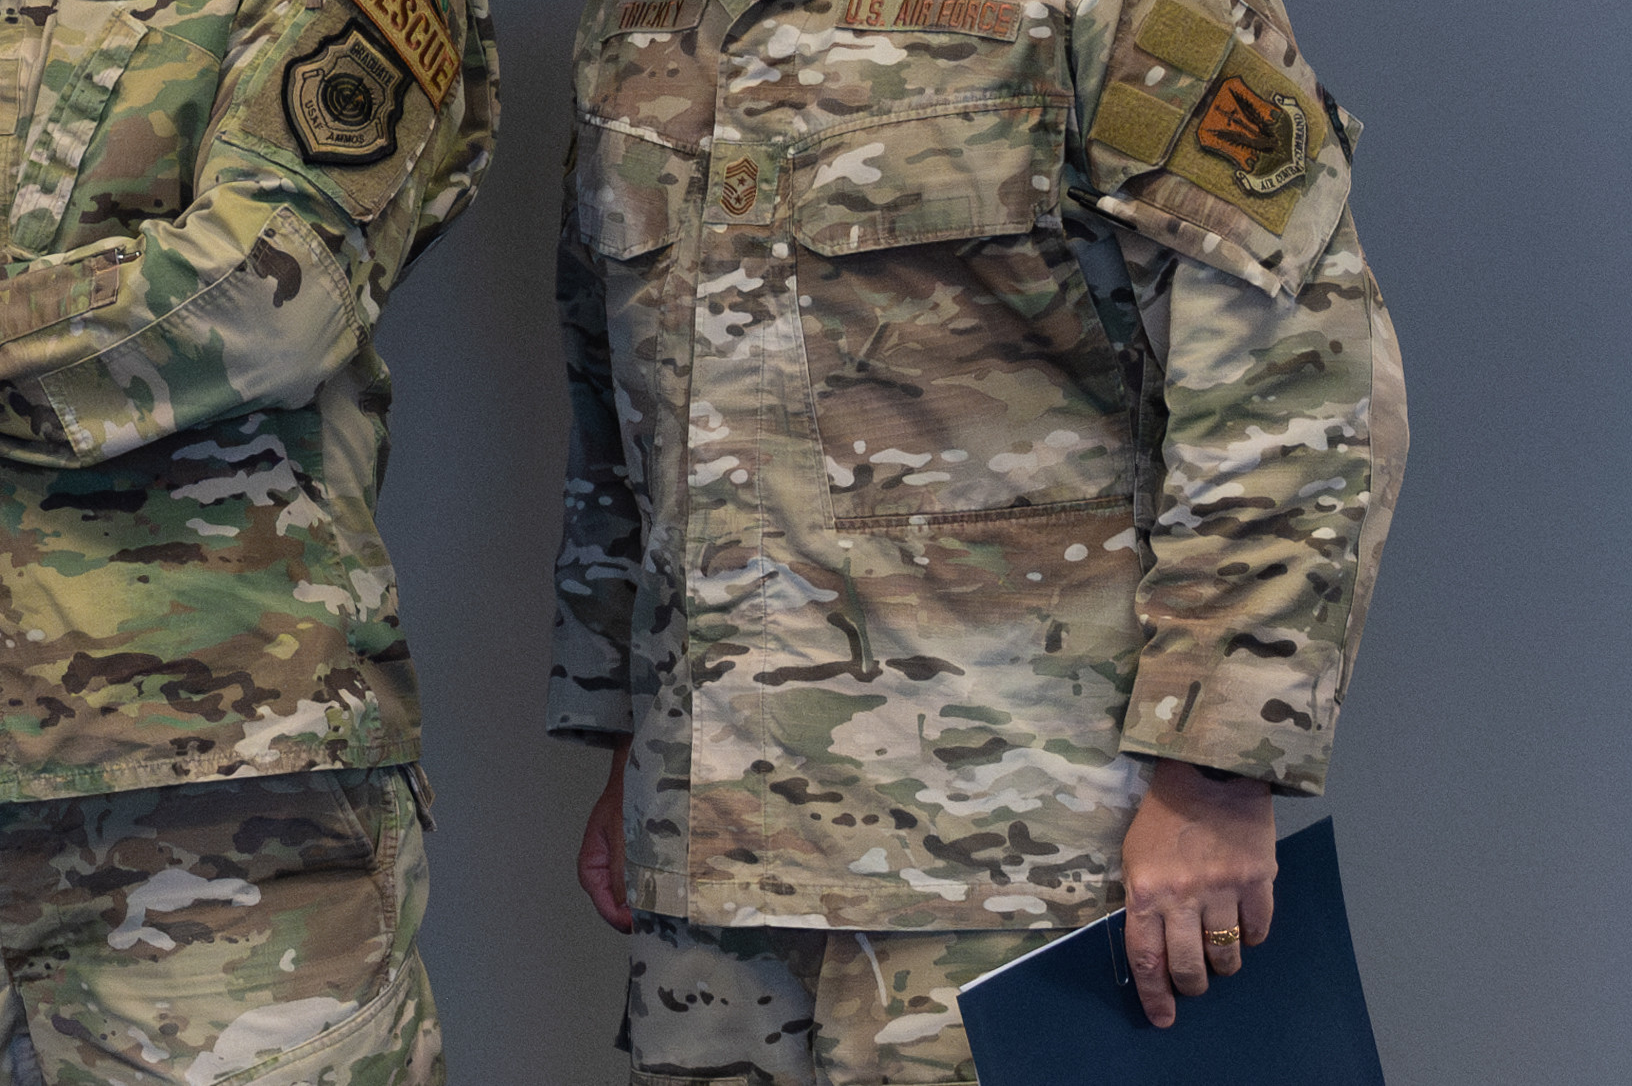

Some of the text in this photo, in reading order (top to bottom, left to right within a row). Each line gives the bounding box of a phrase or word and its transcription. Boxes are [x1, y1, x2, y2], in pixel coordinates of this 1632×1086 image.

[349, 39, 396, 87] GRADUATE
[304, 99, 365, 145] USAF AMMOS
[1260, 113, 1305, 191] AIR COMBAT COMMAND
